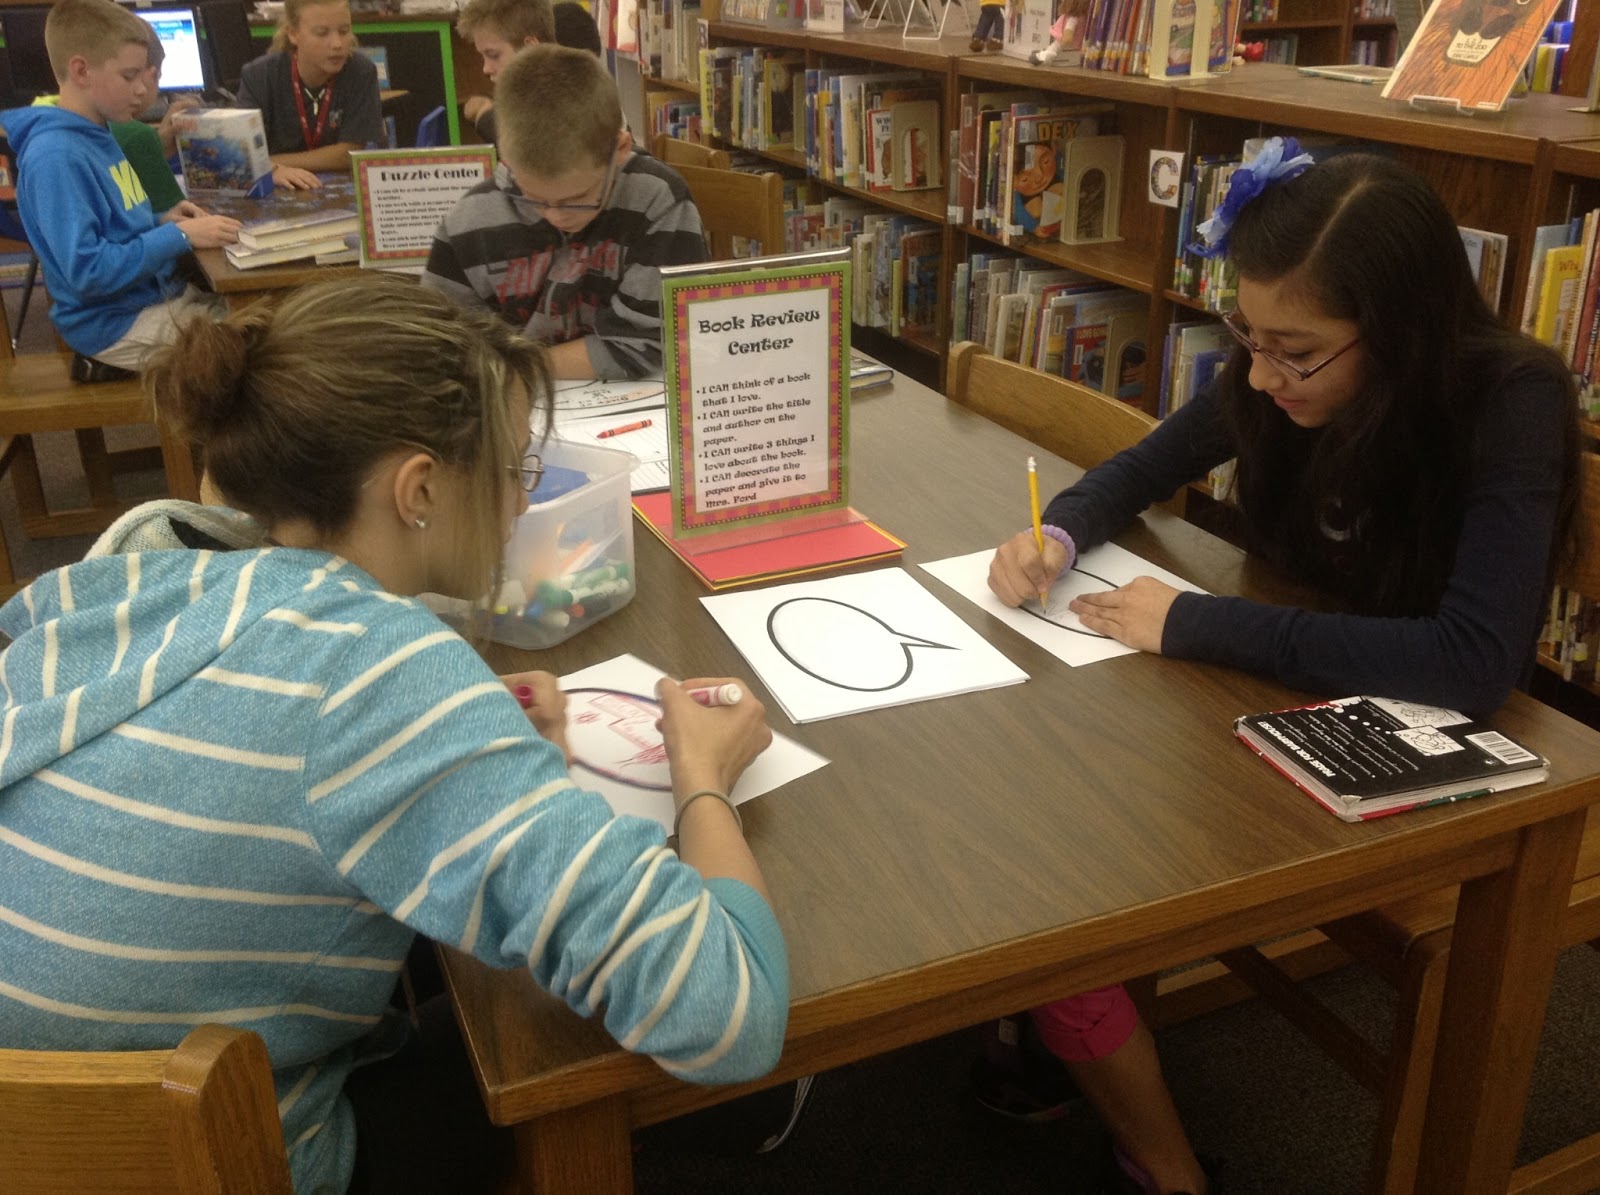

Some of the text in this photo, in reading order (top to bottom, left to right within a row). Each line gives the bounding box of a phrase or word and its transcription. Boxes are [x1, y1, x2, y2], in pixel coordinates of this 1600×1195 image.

[1037, 121, 1080, 140] DEX
[381, 168, 480, 181] Puzzle Center
[1151, 156, 1179, 200] C
[698, 309, 820, 334] Book Review
[728, 337, 794, 356] Center
[702, 386, 708, 394] I
[732, 378, 761, 390] think
[764, 375, 776, 386] of
[786, 372, 811, 383] book
[702, 395, 728, 408] that
[737, 391, 761, 403] love.
[702, 412, 708, 420] I
[732, 405, 763, 417] write
[766, 401, 783, 412] the
[786, 397, 811, 409] title
[703, 411, 796, 434] and author on the
[703, 435, 737, 448] paper.
[704, 449, 709, 458] I
[733, 442, 764, 456] write
[766, 440, 773, 450] 3
[775, 435, 808, 448] things
[704, 448, 806, 471] love about the book.
[704, 475, 710, 483] I
[734, 465, 780, 481] decorate
[783, 461, 800, 471] the
[705, 472, 806, 497] paper and give it to
[706, 493, 757, 508] Mrs. Ford
[1296, 749, 1314, 760] FOR
